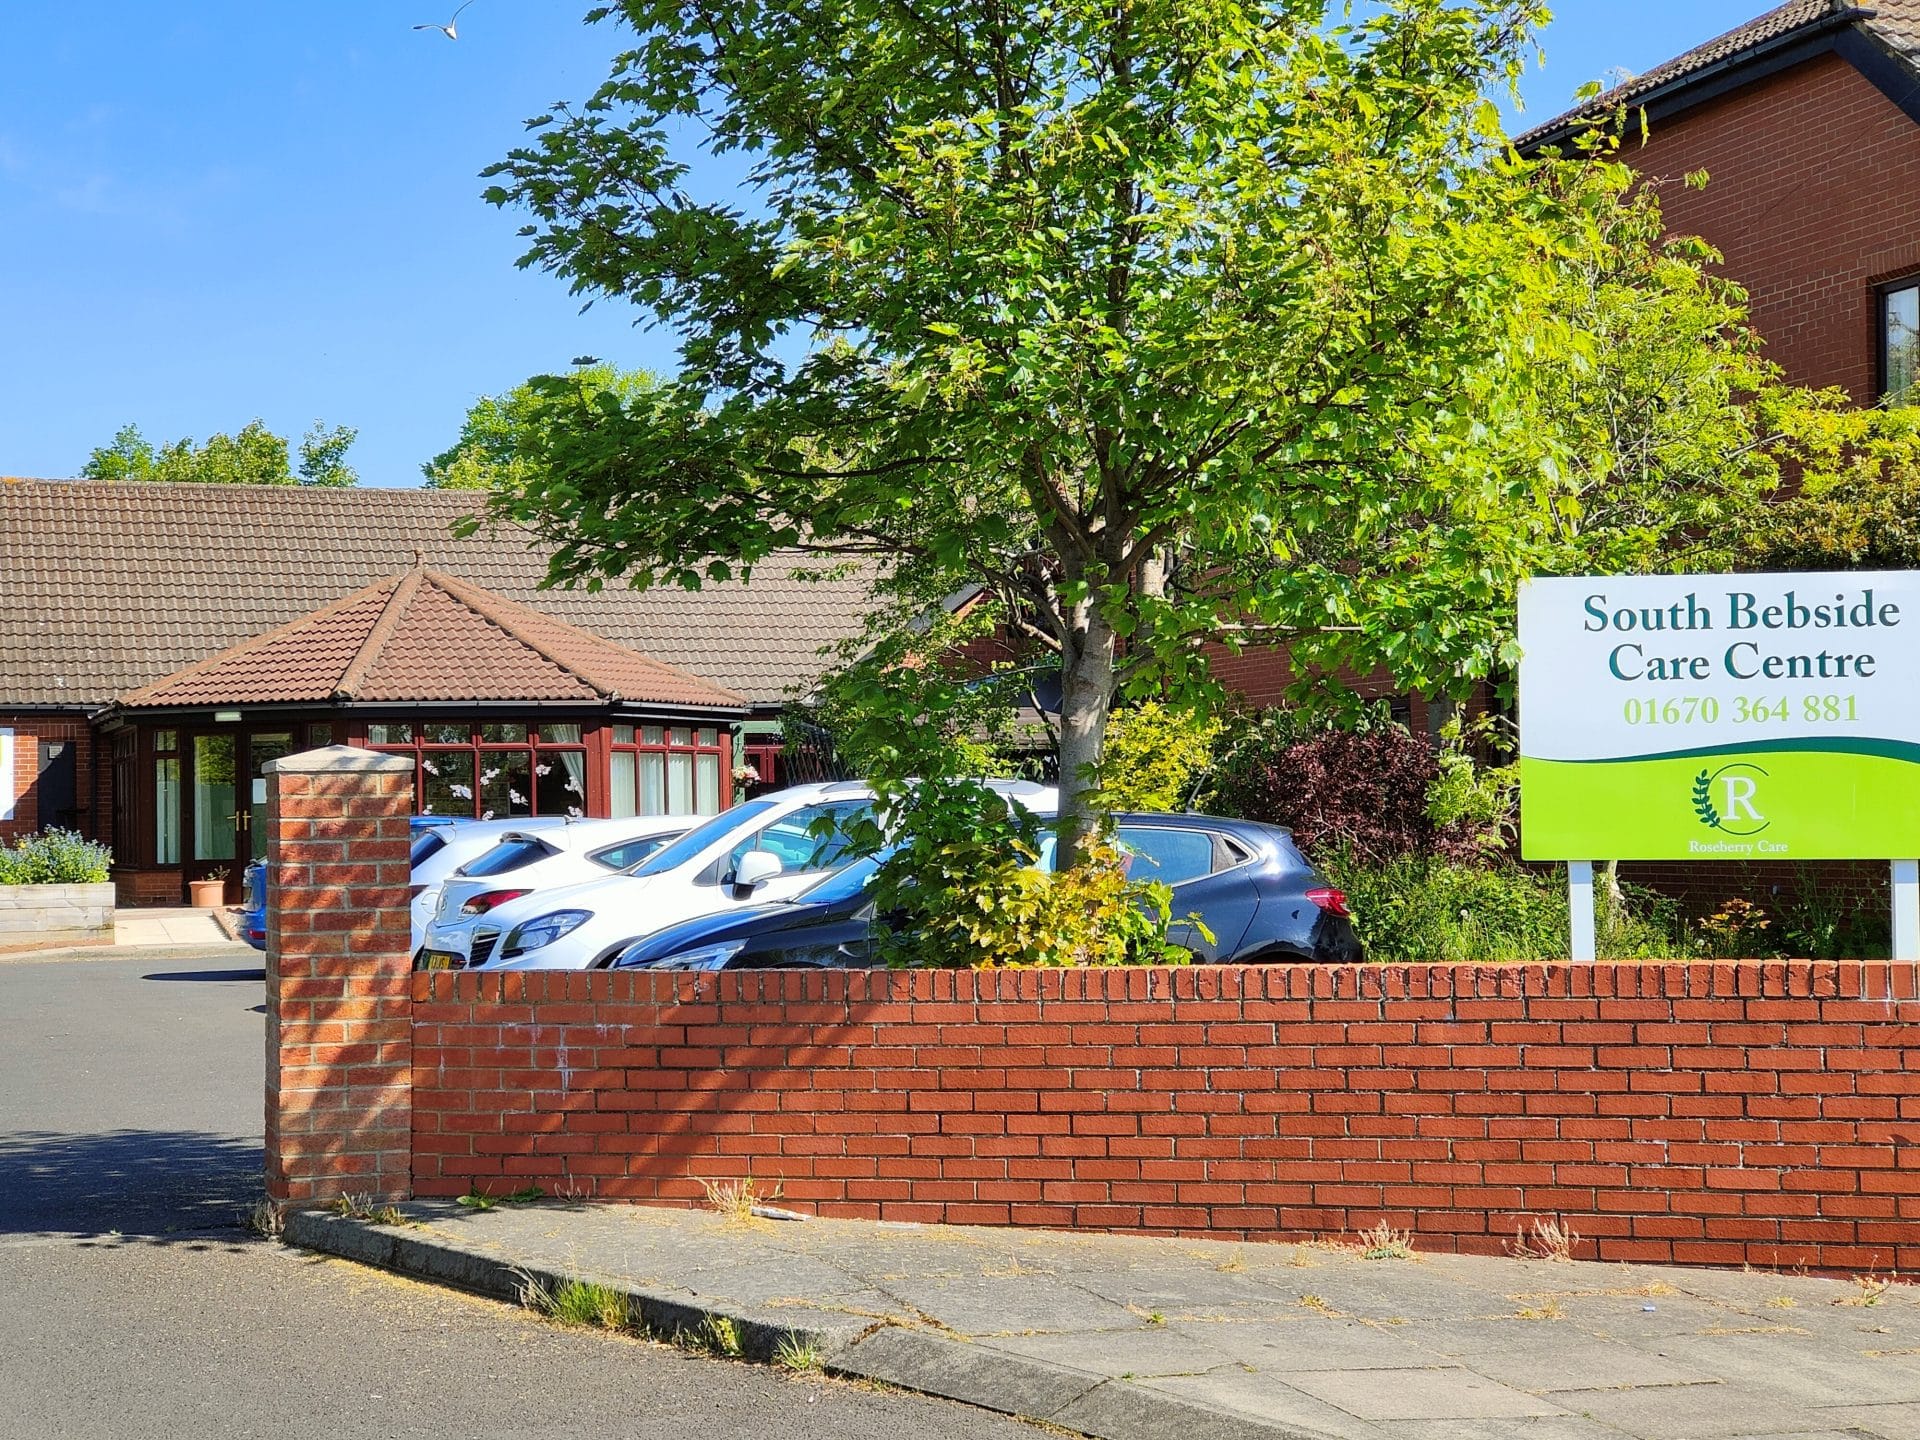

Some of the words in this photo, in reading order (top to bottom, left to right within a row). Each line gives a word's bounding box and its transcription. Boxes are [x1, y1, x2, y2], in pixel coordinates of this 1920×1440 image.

[1584, 593, 1713, 631] South
[1726, 589, 1901, 629] Bebside
[1608, 643, 1710, 681] Care
[1724, 641, 1876, 679] Centre
[1623, 696, 1720, 725] 01670
[1732, 695, 1791, 724] 364
[1803, 694, 1860, 722] 881
[1721, 776, 1764, 821] R
[1688, 840, 1753, 856] Roseberry
[1757, 840, 1788, 853] Care
